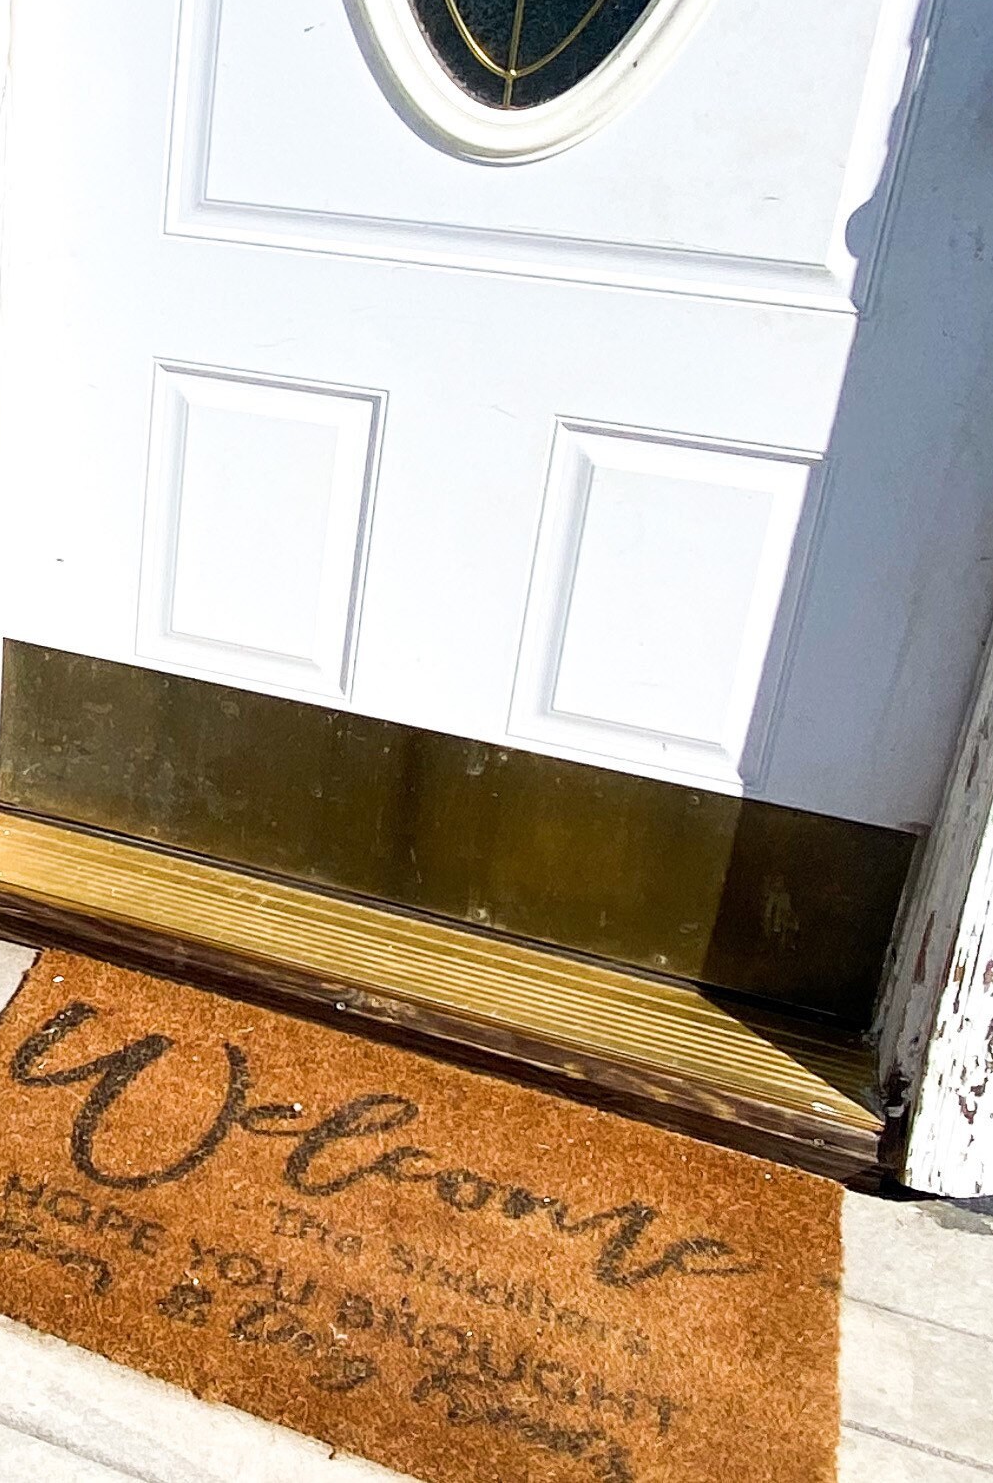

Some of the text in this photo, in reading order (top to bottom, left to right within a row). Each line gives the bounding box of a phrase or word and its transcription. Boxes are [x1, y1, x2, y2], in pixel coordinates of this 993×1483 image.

[2, 1173, 168, 1255] HOPE
[189, 1237, 318, 1306] YOU
[11, 1001, 762, 1289] Welcome
